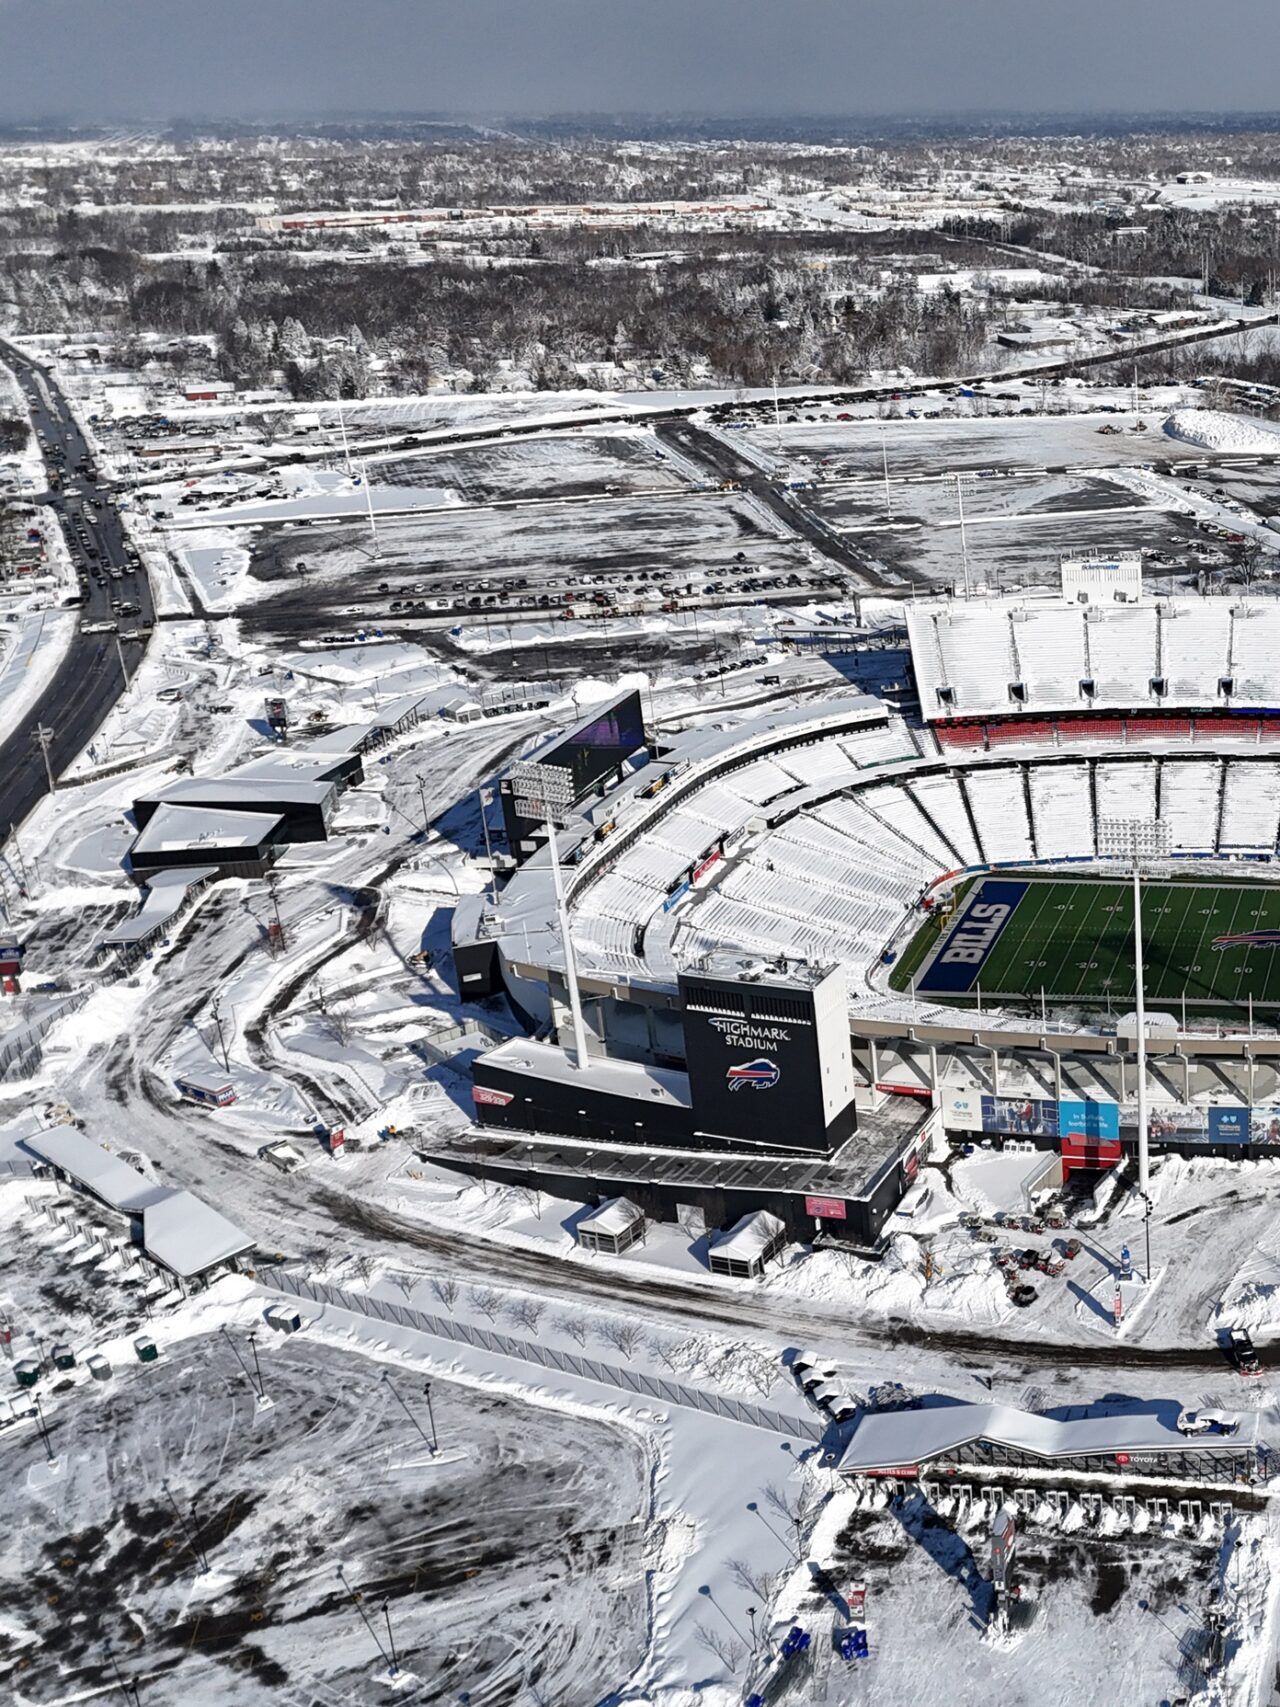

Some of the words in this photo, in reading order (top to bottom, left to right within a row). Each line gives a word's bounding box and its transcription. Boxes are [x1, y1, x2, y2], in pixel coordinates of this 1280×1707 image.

[726, 825, 746, 849] GEICO
[940, 903, 1011, 964] BILLS
[715, 1020, 792, 1041] HIGHMARK
[725, 1034, 778, 1052] STADIUM
